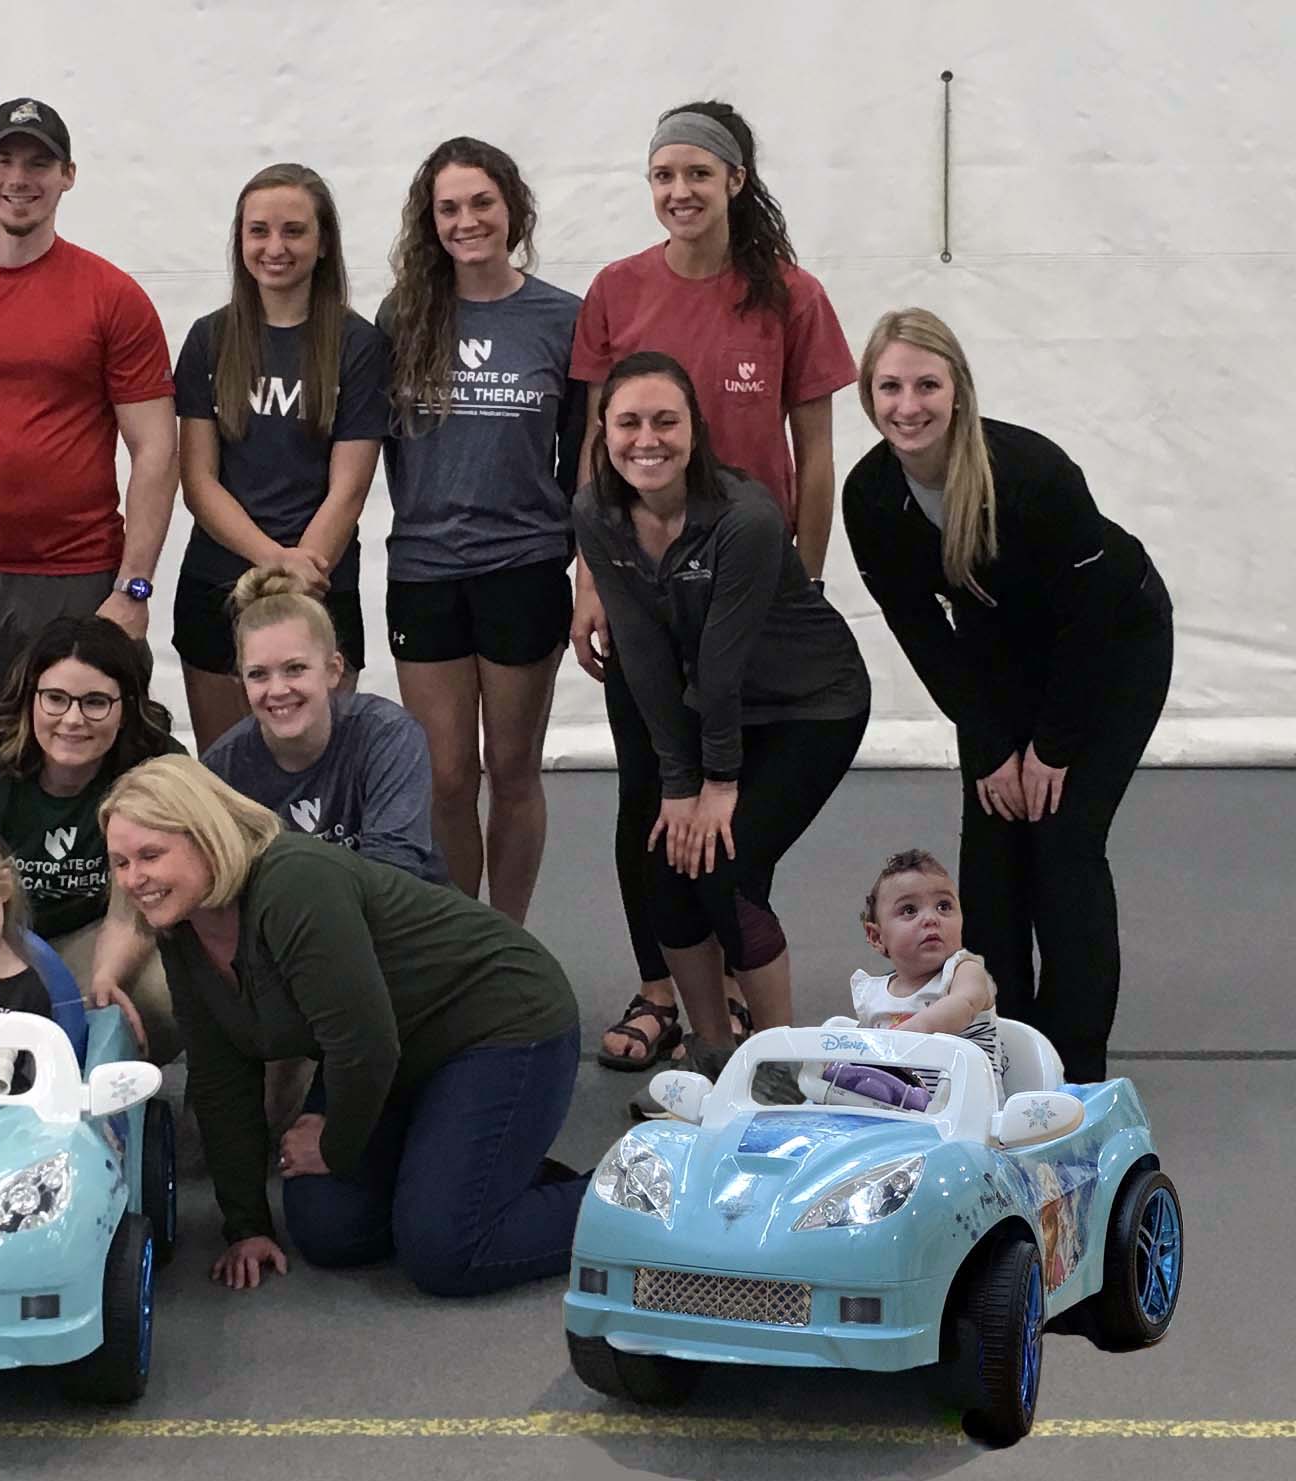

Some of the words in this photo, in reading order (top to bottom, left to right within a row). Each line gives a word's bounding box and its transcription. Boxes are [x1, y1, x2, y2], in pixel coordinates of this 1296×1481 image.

[501, 373, 519, 384] OF
[724, 378, 766, 393] UNMC
[474, 387, 544, 406] THERAPY
[820, 1033, 869, 1056] Disney
